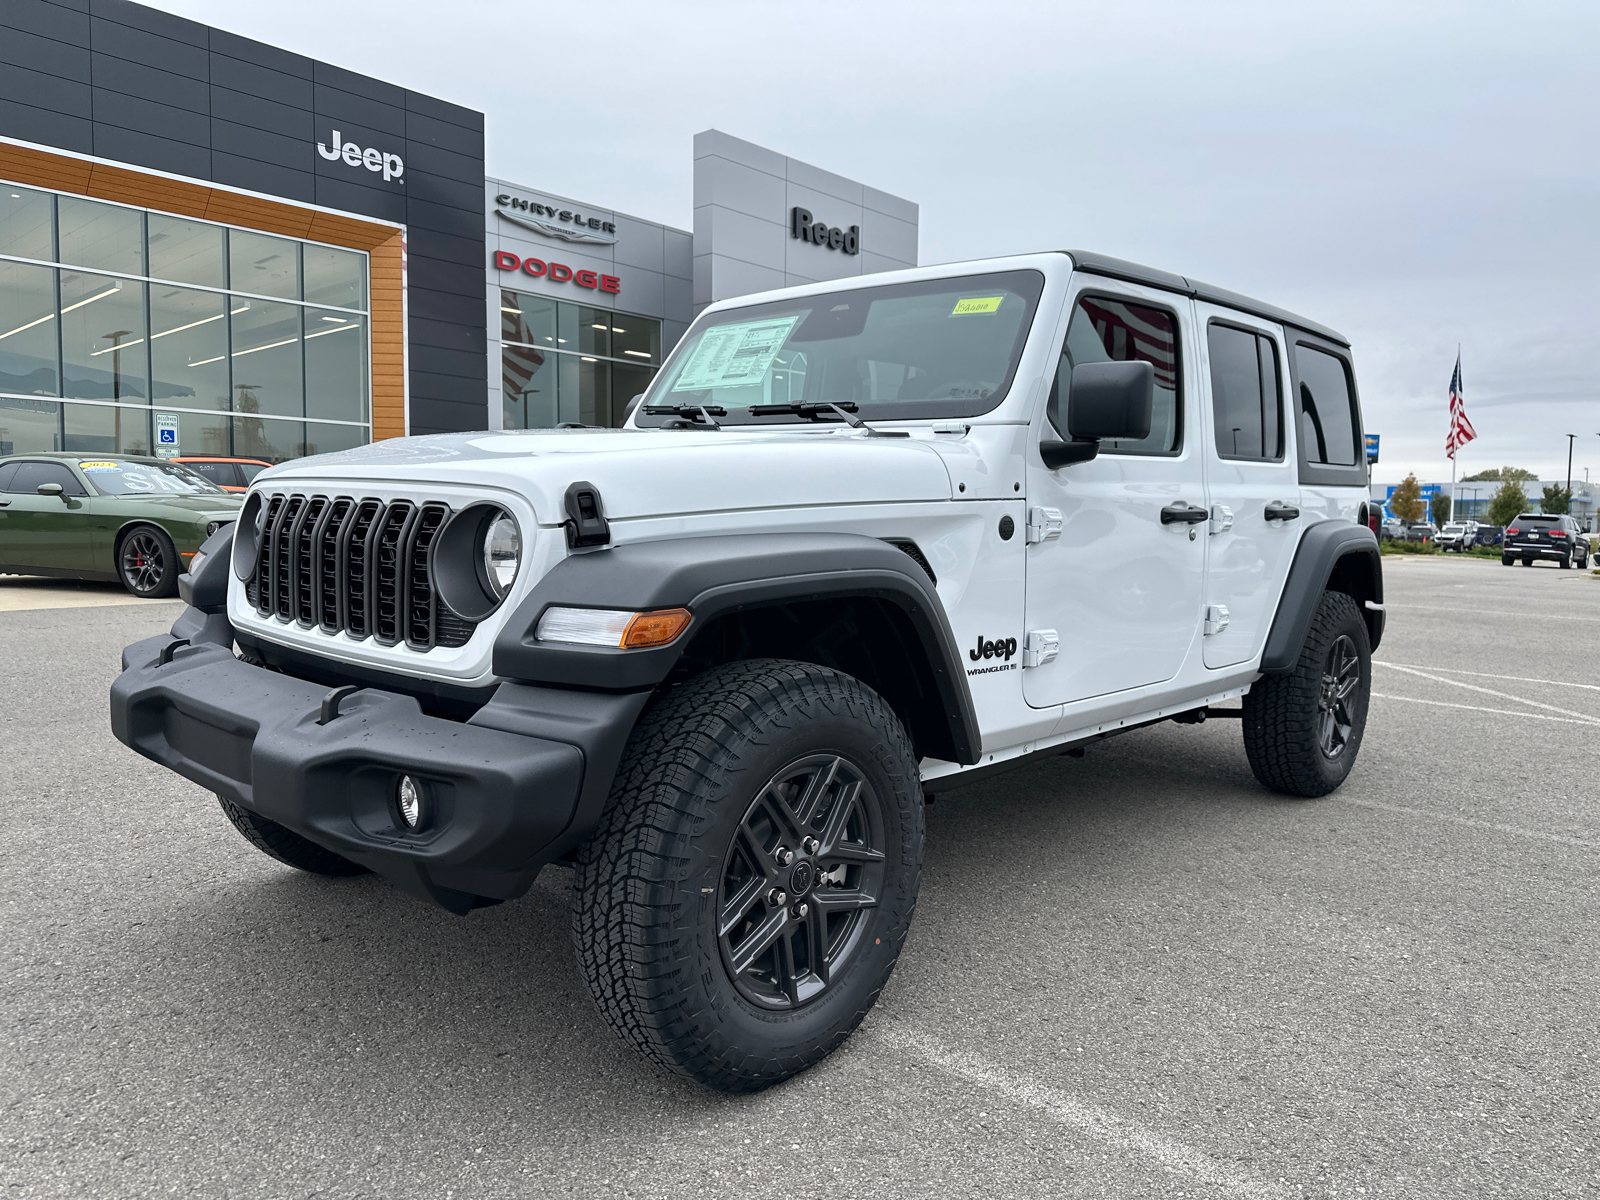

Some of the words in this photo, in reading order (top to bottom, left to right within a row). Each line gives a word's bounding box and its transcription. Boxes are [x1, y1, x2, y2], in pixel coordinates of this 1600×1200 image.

[317, 129, 404, 182] Jeep
[496, 194, 616, 233] CHRYSLER
[791, 206, 860, 256] Reed
[495, 250, 621, 294] DODGE
[969, 635, 1017, 662] Jeep
[967, 664, 1010, 677] WRANGLER
